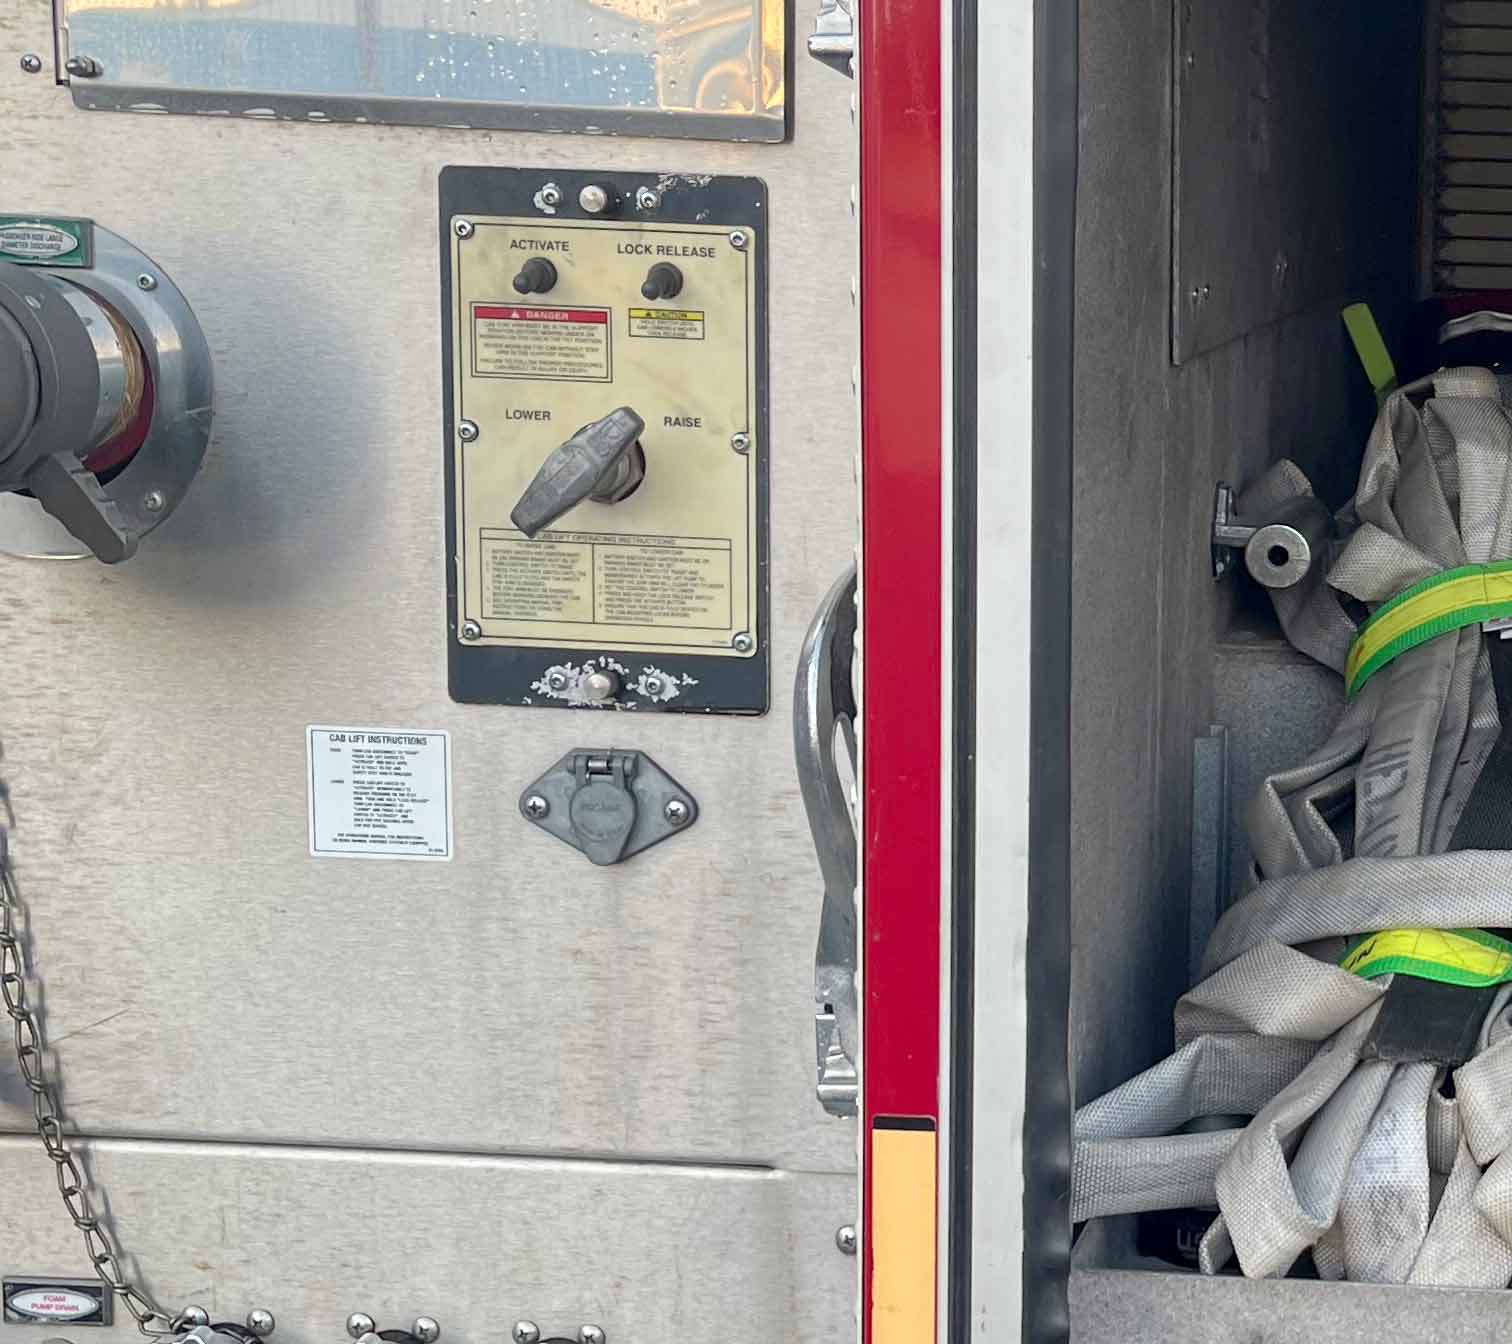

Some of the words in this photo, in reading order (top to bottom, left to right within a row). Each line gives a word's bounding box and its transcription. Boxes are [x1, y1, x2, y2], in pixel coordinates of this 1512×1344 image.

[509, 239, 569, 252] ACTIVATE
[616, 243, 652, 256] LOCK
[656, 245, 716, 258] RELEASE
[525, 310, 569, 321] DANGER
[505, 408, 552, 421] LOWER
[663, 416, 702, 428] RAISE
[329, 733, 346, 743] CAB
[348, 734, 365, 744] LIFT
[367, 735, 428, 746] INSTRUCTIONS
